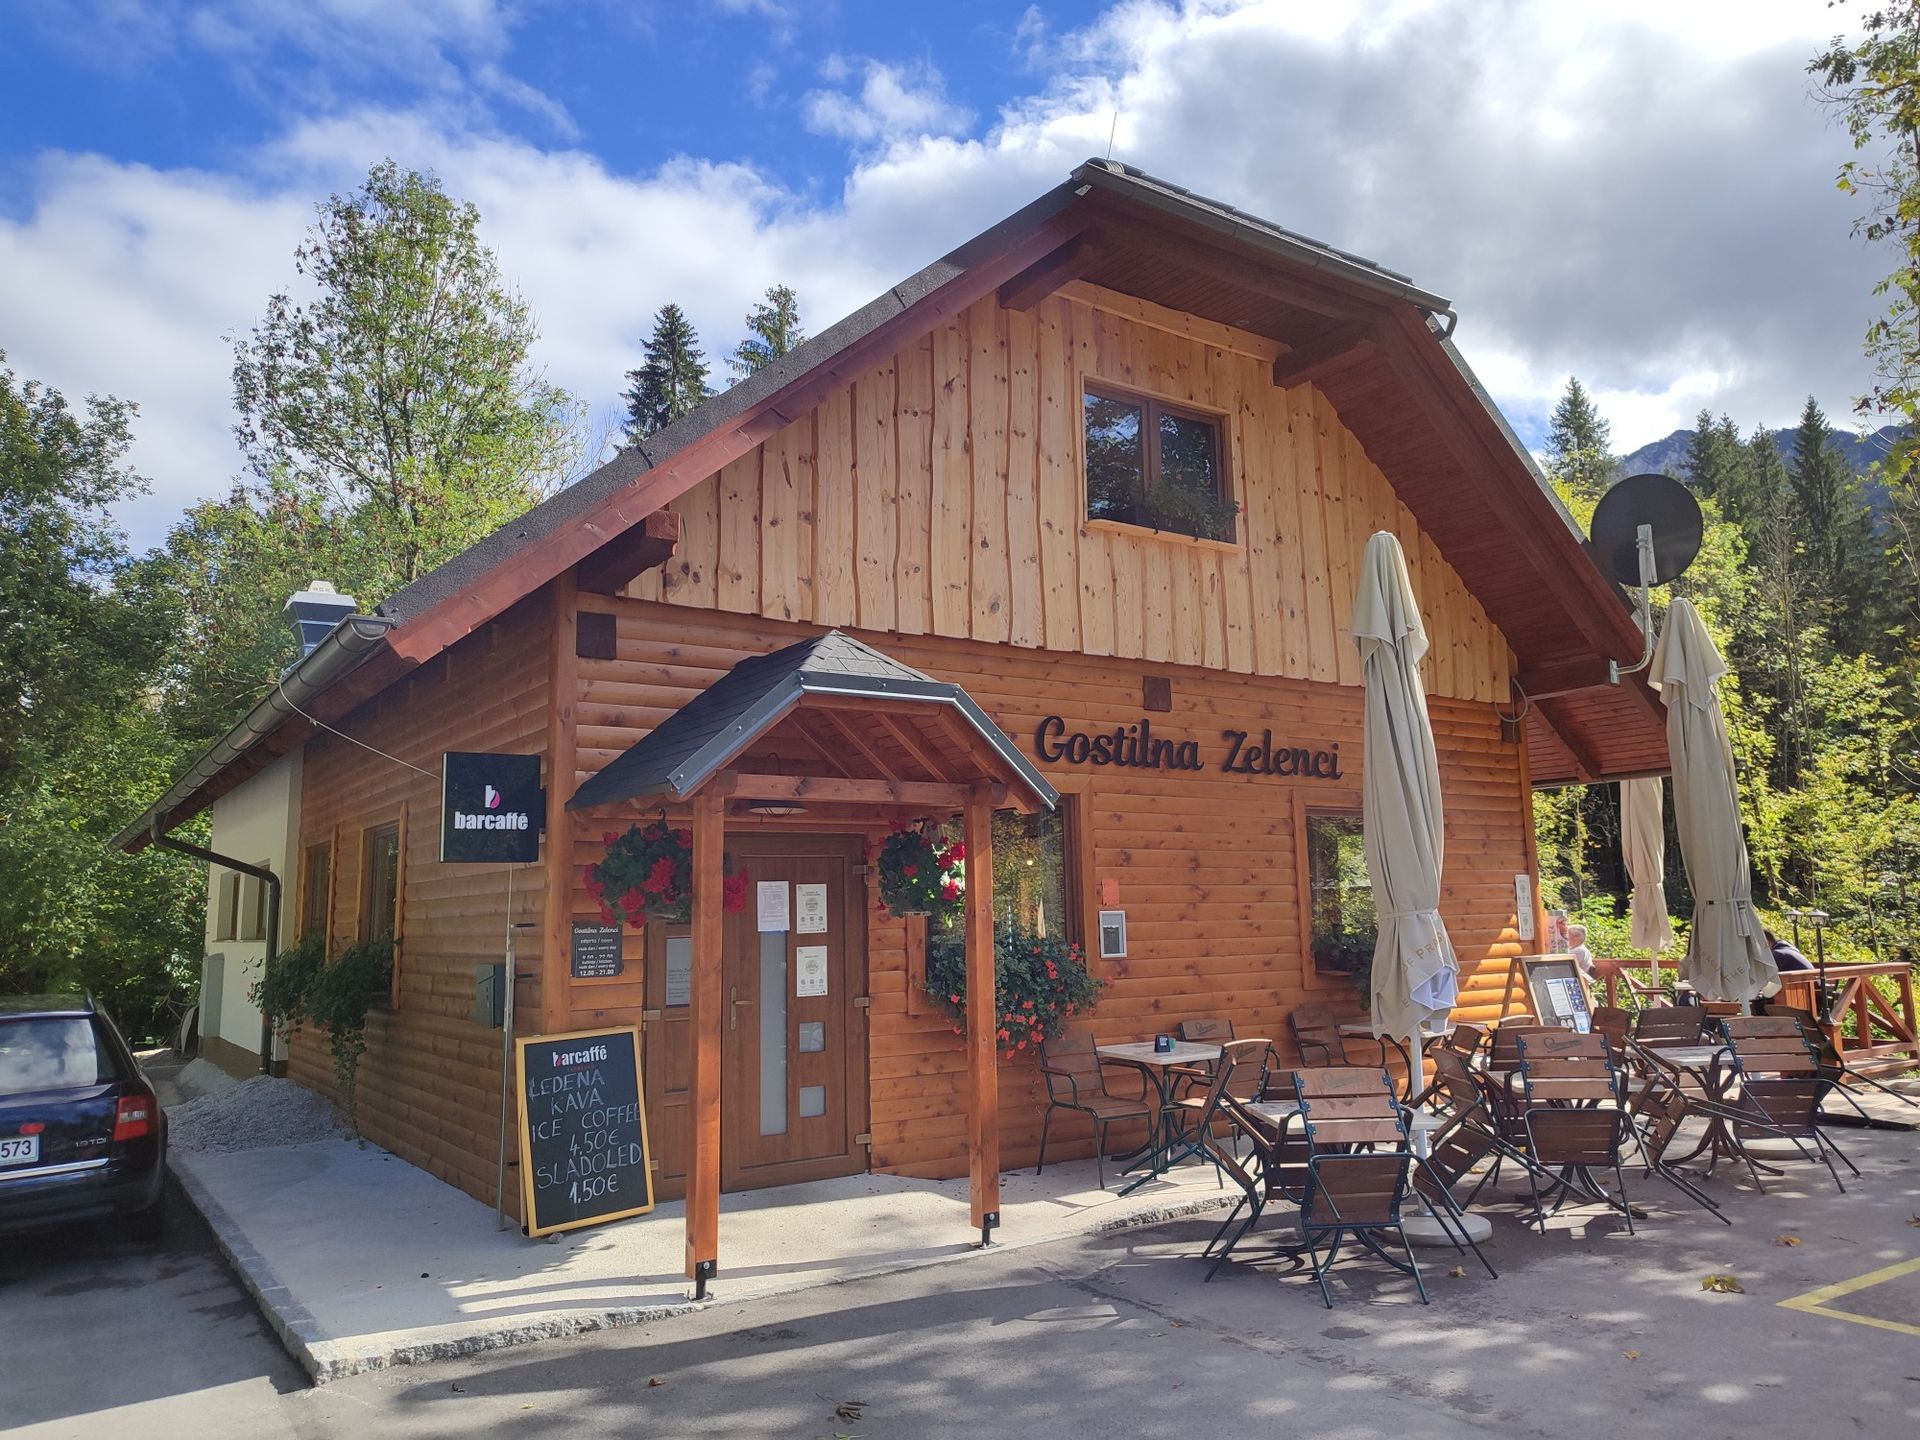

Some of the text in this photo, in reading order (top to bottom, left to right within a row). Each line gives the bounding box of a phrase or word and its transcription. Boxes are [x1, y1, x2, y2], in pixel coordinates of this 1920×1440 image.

[1035, 715, 1343, 780] Gostilna Zelenci
[454, 811, 528, 830] barcaffé
[552, 1045, 608, 1068] barcaffé
[528, 1069, 606, 1100] LEDENA
[551, 1087, 604, 1116] KAVA
[532, 1103, 641, 1143] ICE COFFEE
[1, 1140, 32, 1158] 573
[536, 1142, 642, 1189] SLADOLED
